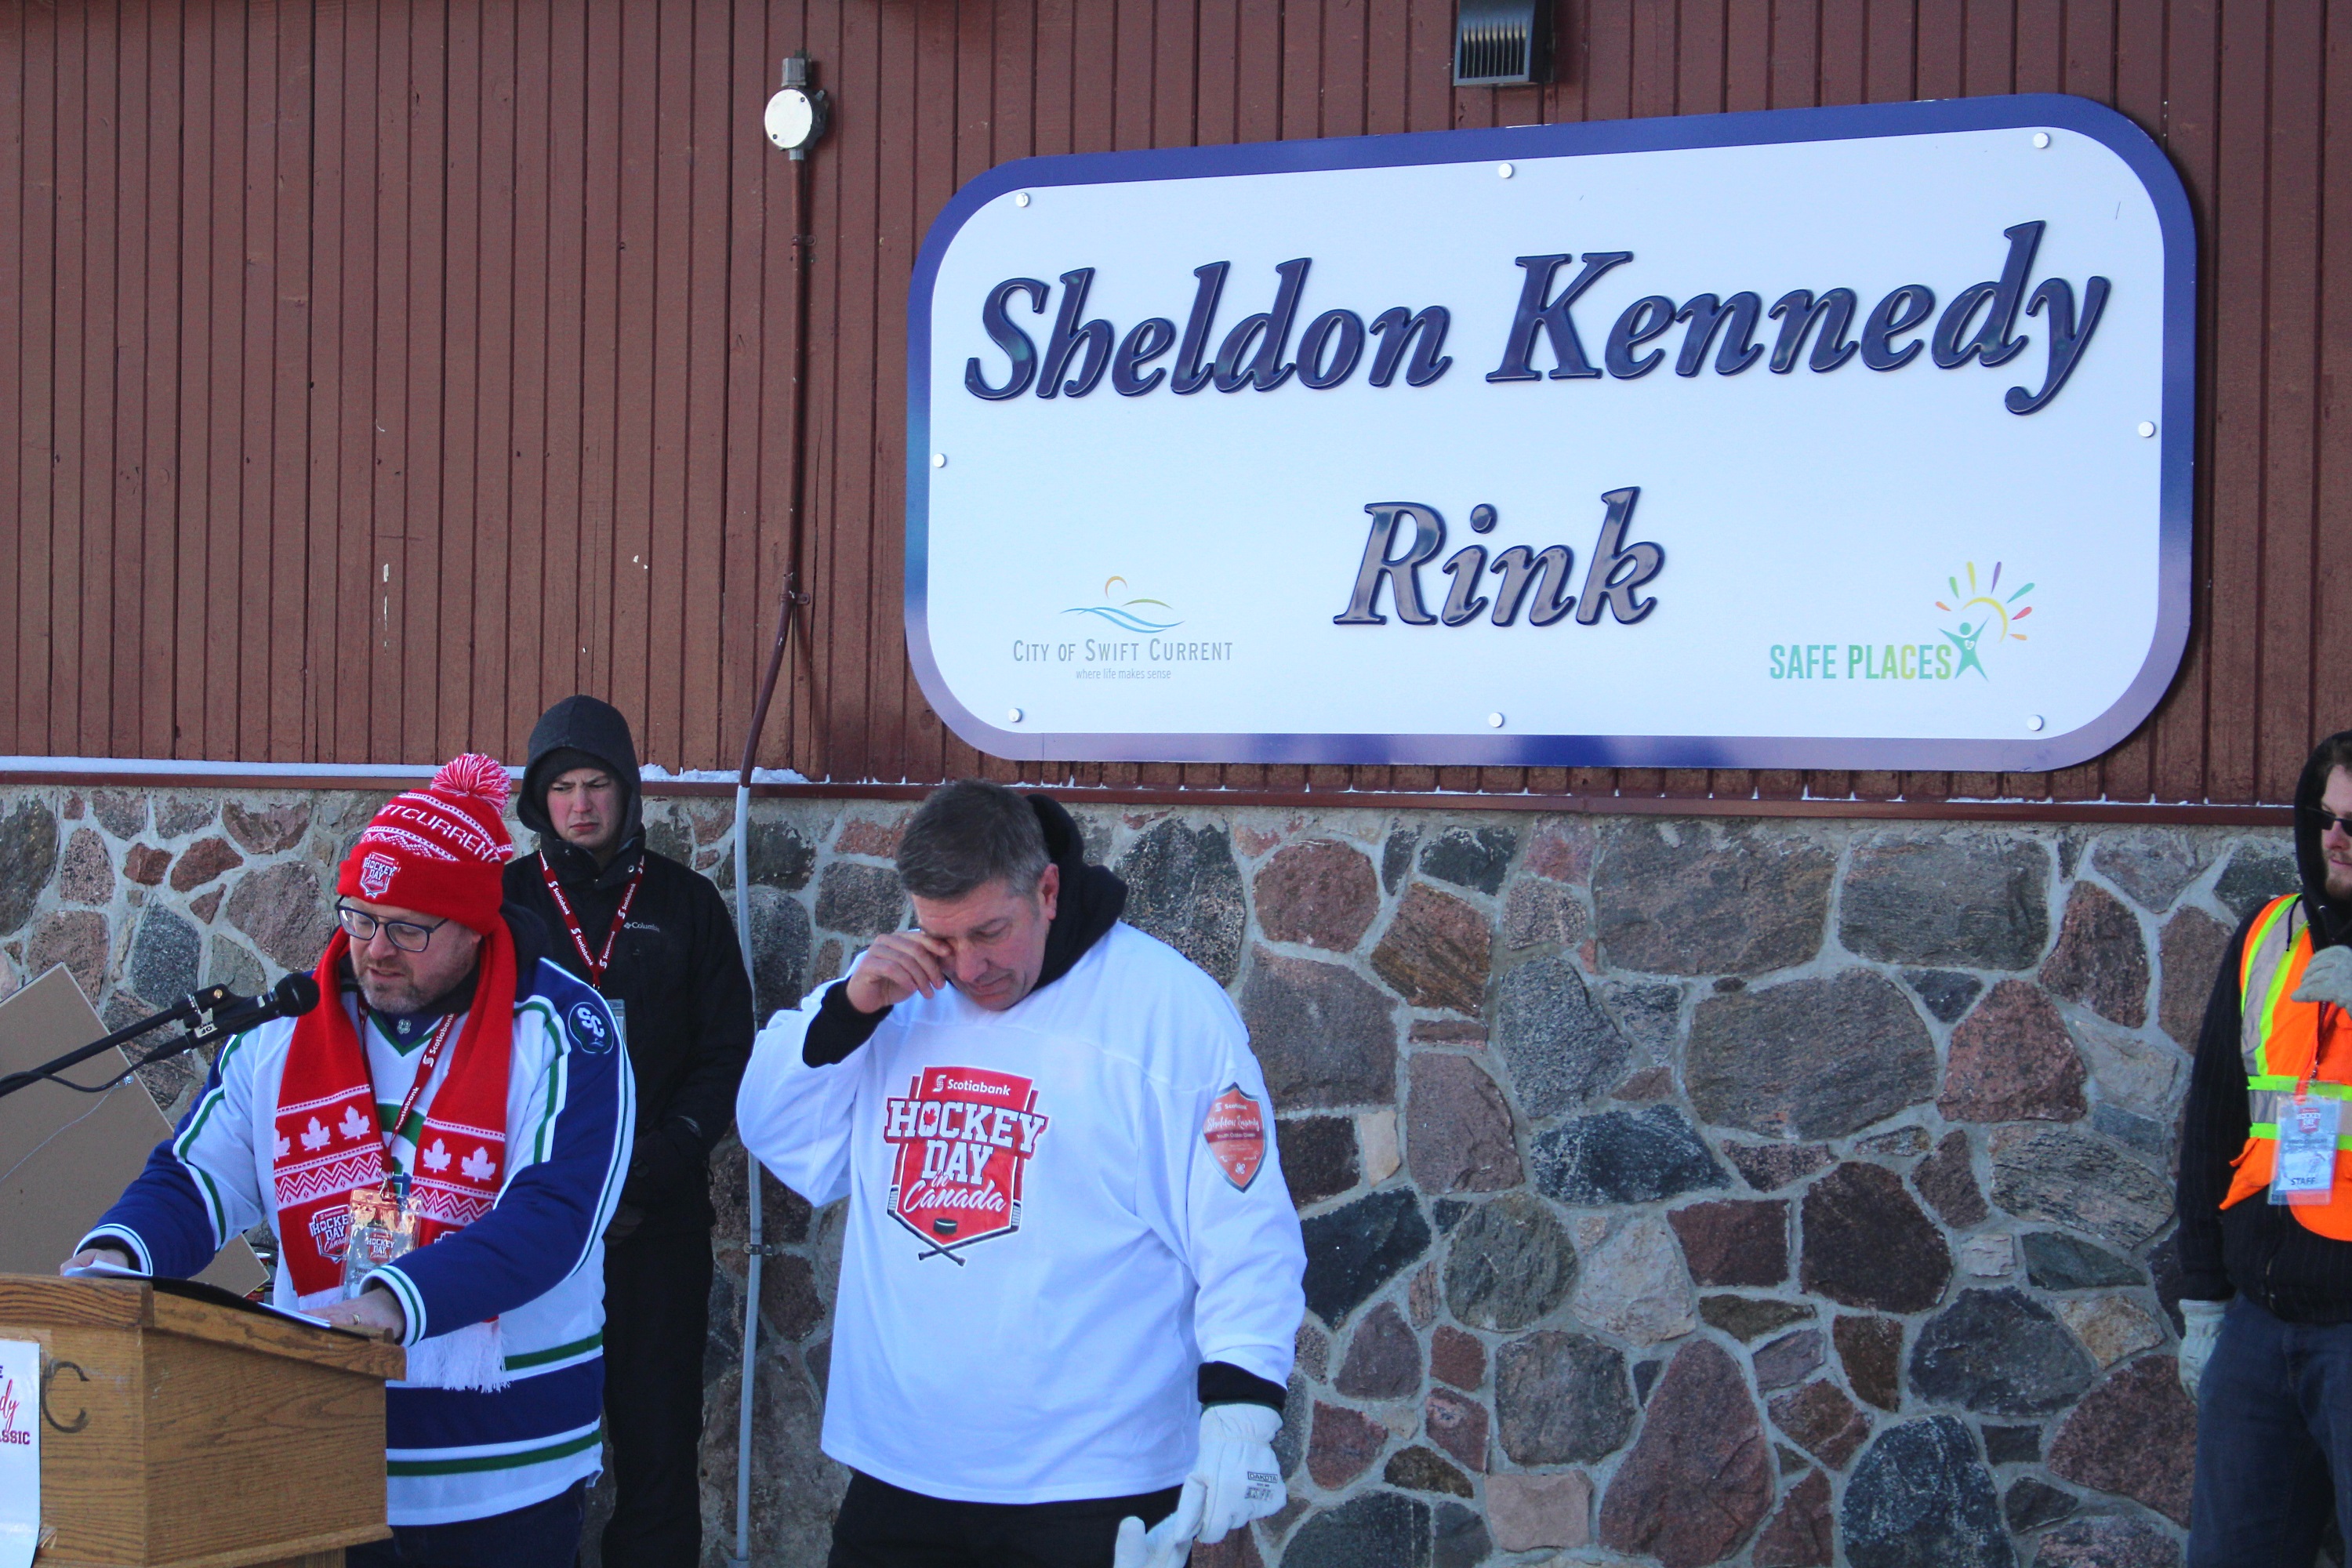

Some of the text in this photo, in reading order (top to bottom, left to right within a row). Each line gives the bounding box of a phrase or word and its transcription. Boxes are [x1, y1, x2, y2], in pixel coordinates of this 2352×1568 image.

[964, 220, 2111, 416] Sheldon Kennedy
[1333, 486, 1664, 627] Rink
[1013, 637, 1233, 662] CITY OF SWIFT CURRENT
[1769, 644, 1952, 680] SAFE PLACES
[1076, 668, 1171, 679] where life makes sense
[365, 859, 397, 877] HOCKEY
[369, 869, 384, 880] DAY
[554, 887, 571, 915] Scotiabank
[622, 883, 636, 910] Scotiabank
[576, 935, 593, 966] Scotiabank
[603, 931, 615, 960] Scotiabank
[430, 1013, 454, 1054] Scotiabank
[947, 1079, 1011, 1096] Scotiabank
[395, 1087, 419, 1131] Scotiabank
[887, 1099, 1047, 1153] HOCKEY
[921, 1139, 994, 1185] DAY
[931, 1171, 949, 1187] in
[2291, 1177, 2316, 1185] STAFF
[903, 1179, 1007, 1212] Canada
[312, 1215, 349, 1236] HOCKE
[325, 1225, 345, 1240] DAY
[366, 1238, 395, 1249] HOCKEY
[373, 1245, 387, 1254] DAY
[0, 1429, 31, 1445] SSIC
[1250, 1473, 1277, 1482] DAKOTA
